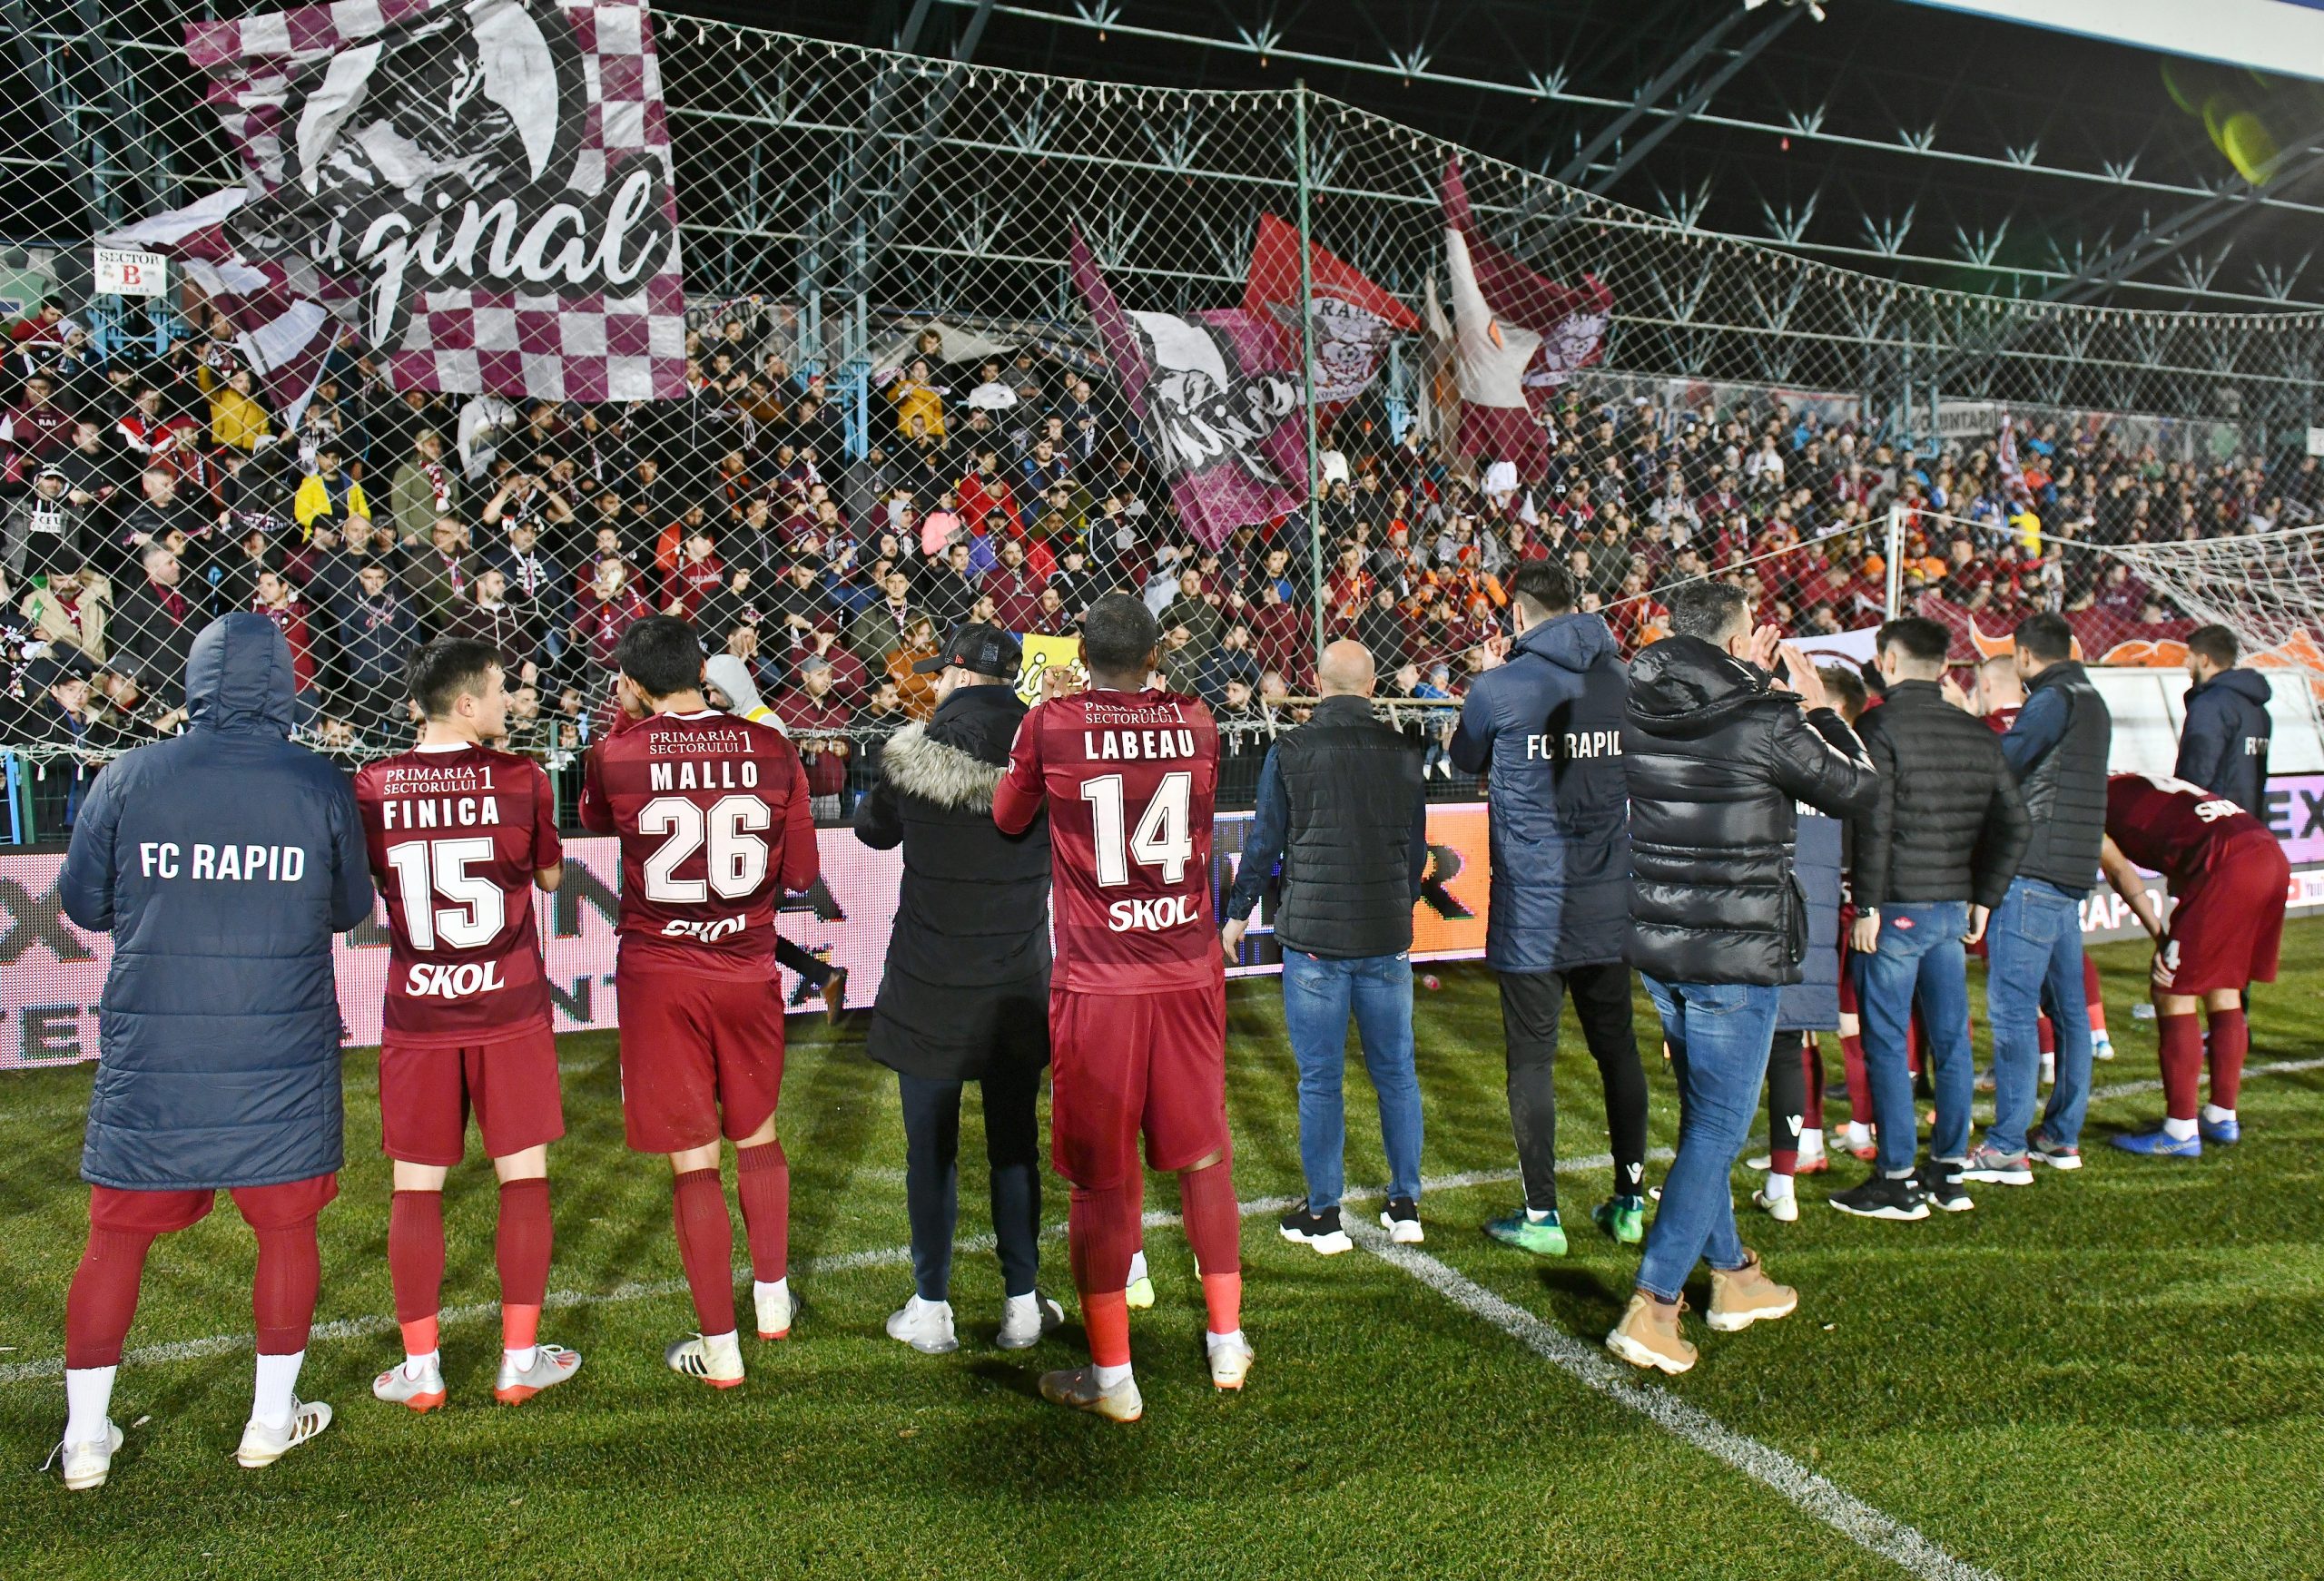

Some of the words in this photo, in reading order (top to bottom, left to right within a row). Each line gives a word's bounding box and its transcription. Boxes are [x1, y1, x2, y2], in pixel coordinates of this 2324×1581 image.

[99, 251, 160, 265] SECTOR
[240, 170, 658, 351] iginal
[123, 264, 141, 285] B
[1084, 702, 1169, 716] PRIMRIA
[1085, 712, 1174, 724] SECTORULUI
[1169, 702, 1187, 724] 1
[649, 729, 738, 743] PRIMARIA
[649, 741, 739, 755] SECTORULUI
[739, 730, 755, 753] 1
[1084, 729, 1196, 760] LABEAU
[1527, 733, 1555, 761] FC
[383, 779, 477, 796] SECTORULUI
[478, 765, 496, 790] 1
[385, 765, 477, 783] PRIMARIA
[650, 761, 758, 791] MALLO
[383, 796, 500, 830] FINICA
[1080, 771, 1193, 888] 14
[140, 842, 181, 879] FC
[192, 843, 305, 882] RAPID
[638, 794, 772, 903] 26
[386, 836, 506, 951] 15
[1108, 894, 1198, 933] SKOL
[405, 960, 505, 1000] SKOL
